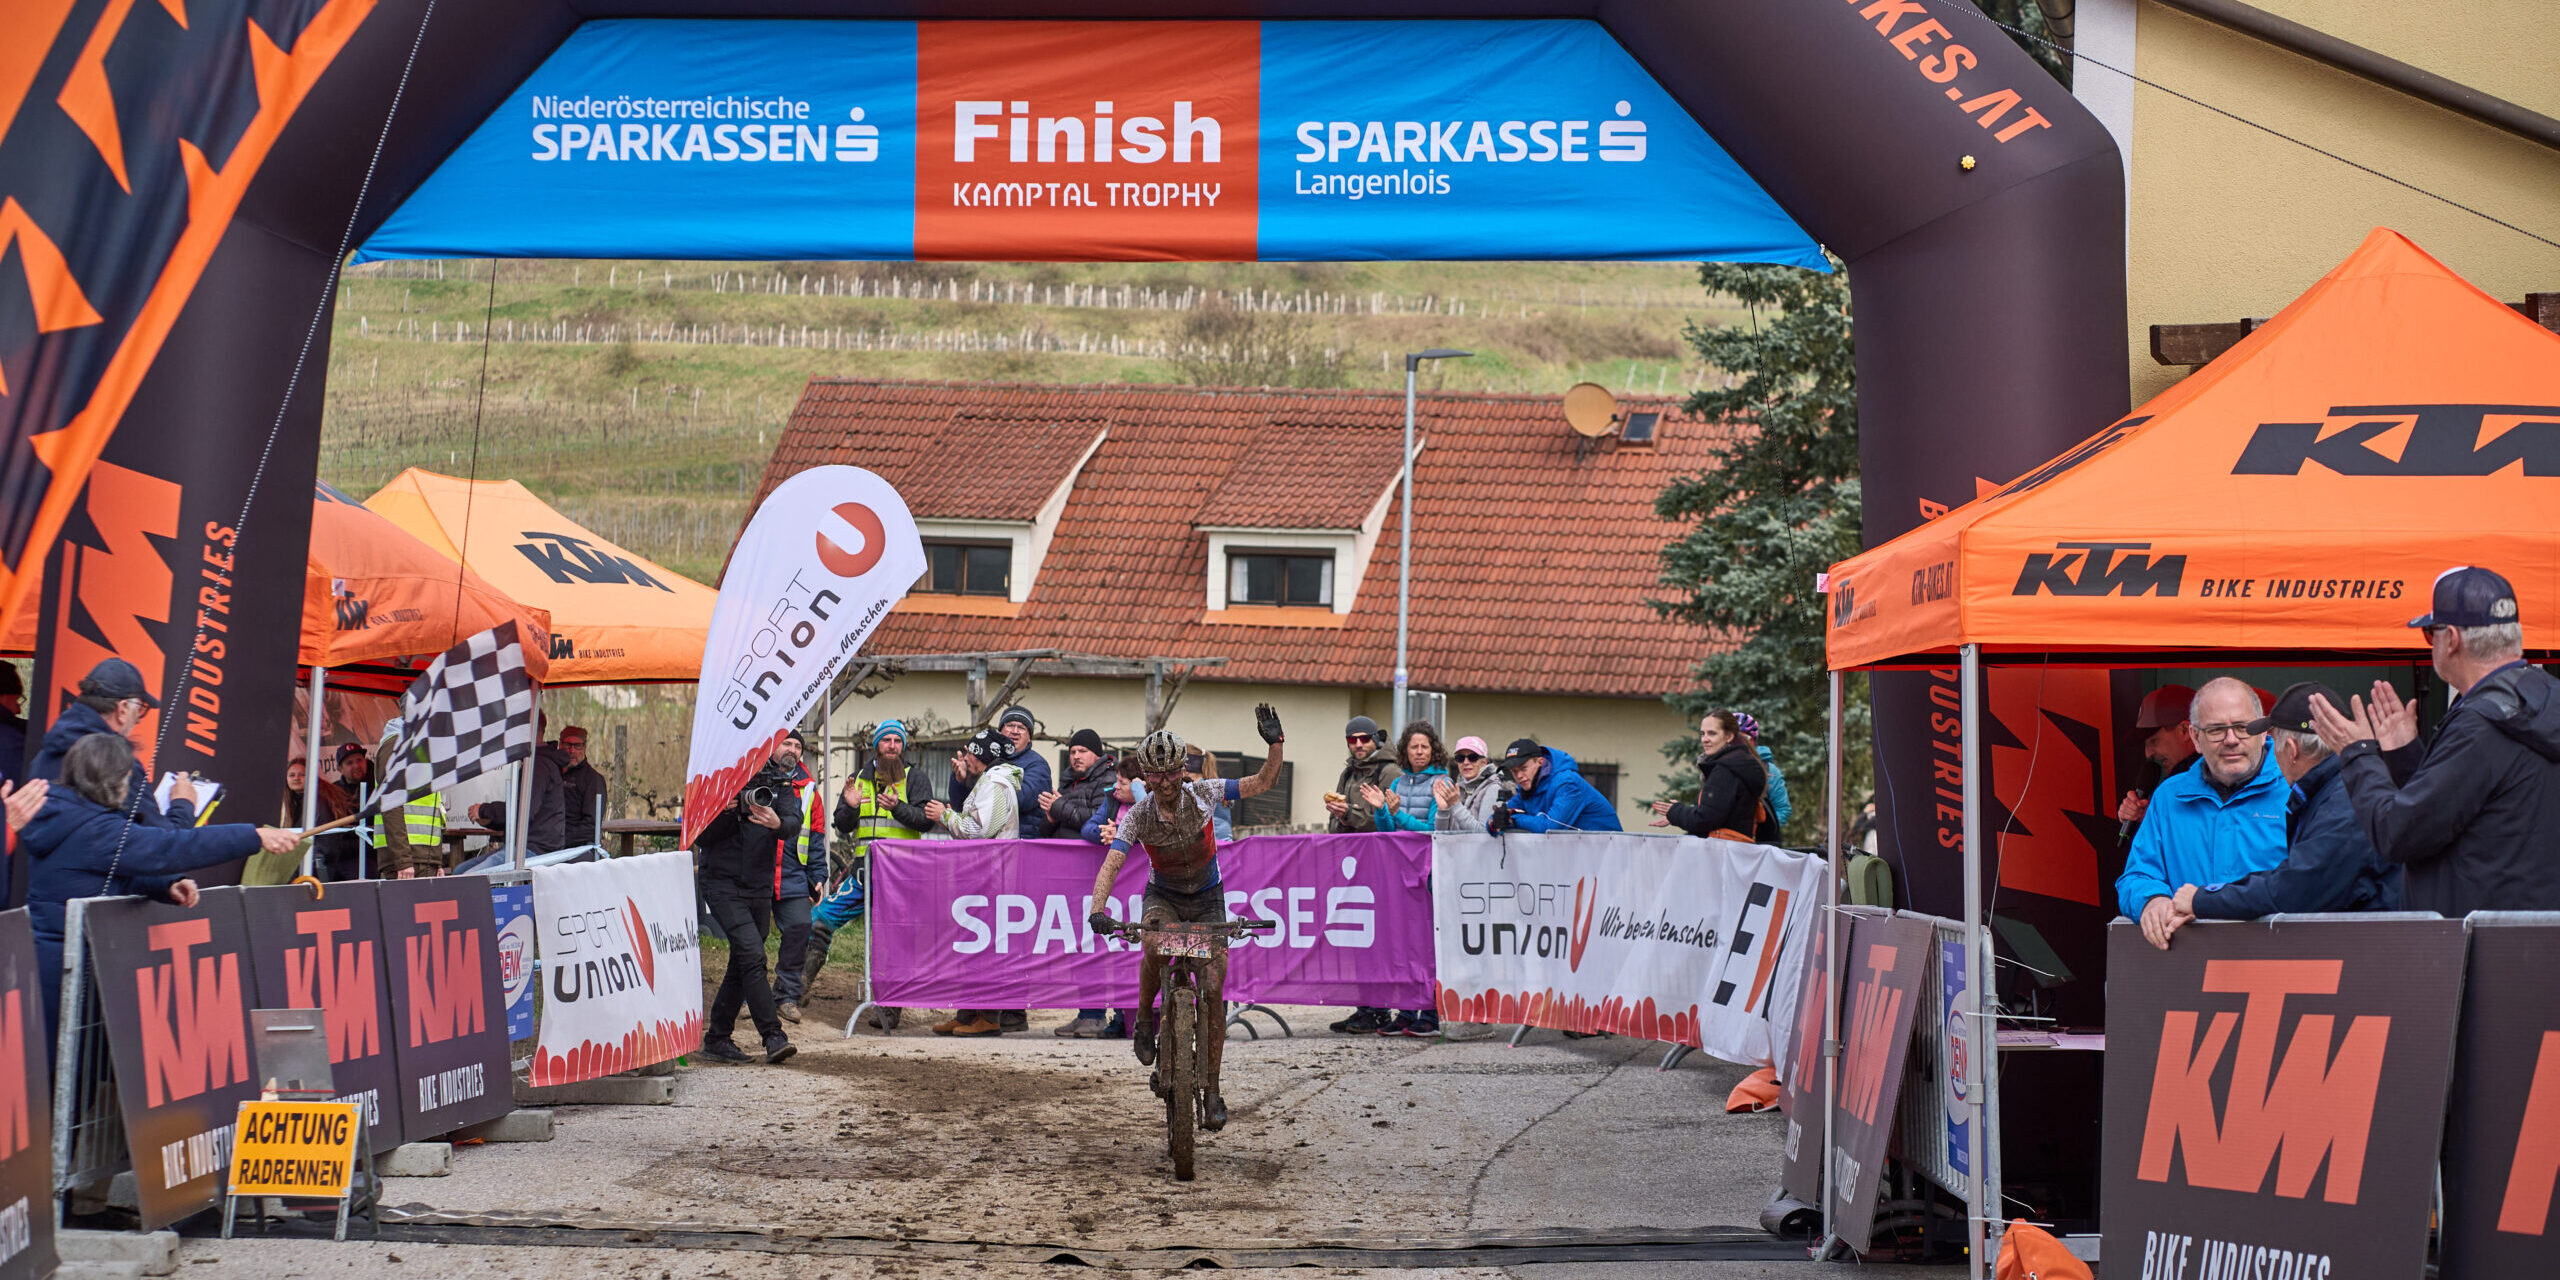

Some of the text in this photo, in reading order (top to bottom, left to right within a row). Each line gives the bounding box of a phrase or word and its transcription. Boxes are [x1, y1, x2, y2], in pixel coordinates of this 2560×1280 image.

[1846, 0, 2053, 144] KES.AT
[531, 95, 811, 121] Niederösterreichische
[953, 100, 1222, 163] Finish
[531, 123, 828, 162] SPARKASSEN
[1295, 120, 1590, 163] SPARKASSE
[953, 181, 1221, 207] KAMPTAL TROPHY
[1295, 168, 1451, 200] Langenlois
[513, 531, 677, 594] KTM
[2012, 542, 2405, 600] KTM BIKE INDUSTRIES
[184, 520, 238, 757] INDUSTRIES
[548, 633, 575, 660] TM
[716, 568, 812, 720] SPORT
[801, 653, 842, 702] bewegen
[839, 597, 889, 655] Menschen
[1929, 667, 1965, 854] DUSTRIES
[951, 885, 1317, 955] SPARSSE
[1459, 881, 1571, 916] SPORT
[1599, 906, 1625, 939] Wir
[285, 907, 381, 1065] KTM
[406, 899, 486, 1049] KTM
[136, 917, 250, 1110] KTM
[418, 1074, 438, 1113] BIKE
[439, 1062, 485, 1107] INDUSTRIES
[2137, 959, 2392, 1206] KTM
[243, 1111, 349, 1145] ACHTUNG
[238, 1158, 344, 1187] RADRENNEN
[2141, 1230, 2192, 1280] BIKE
